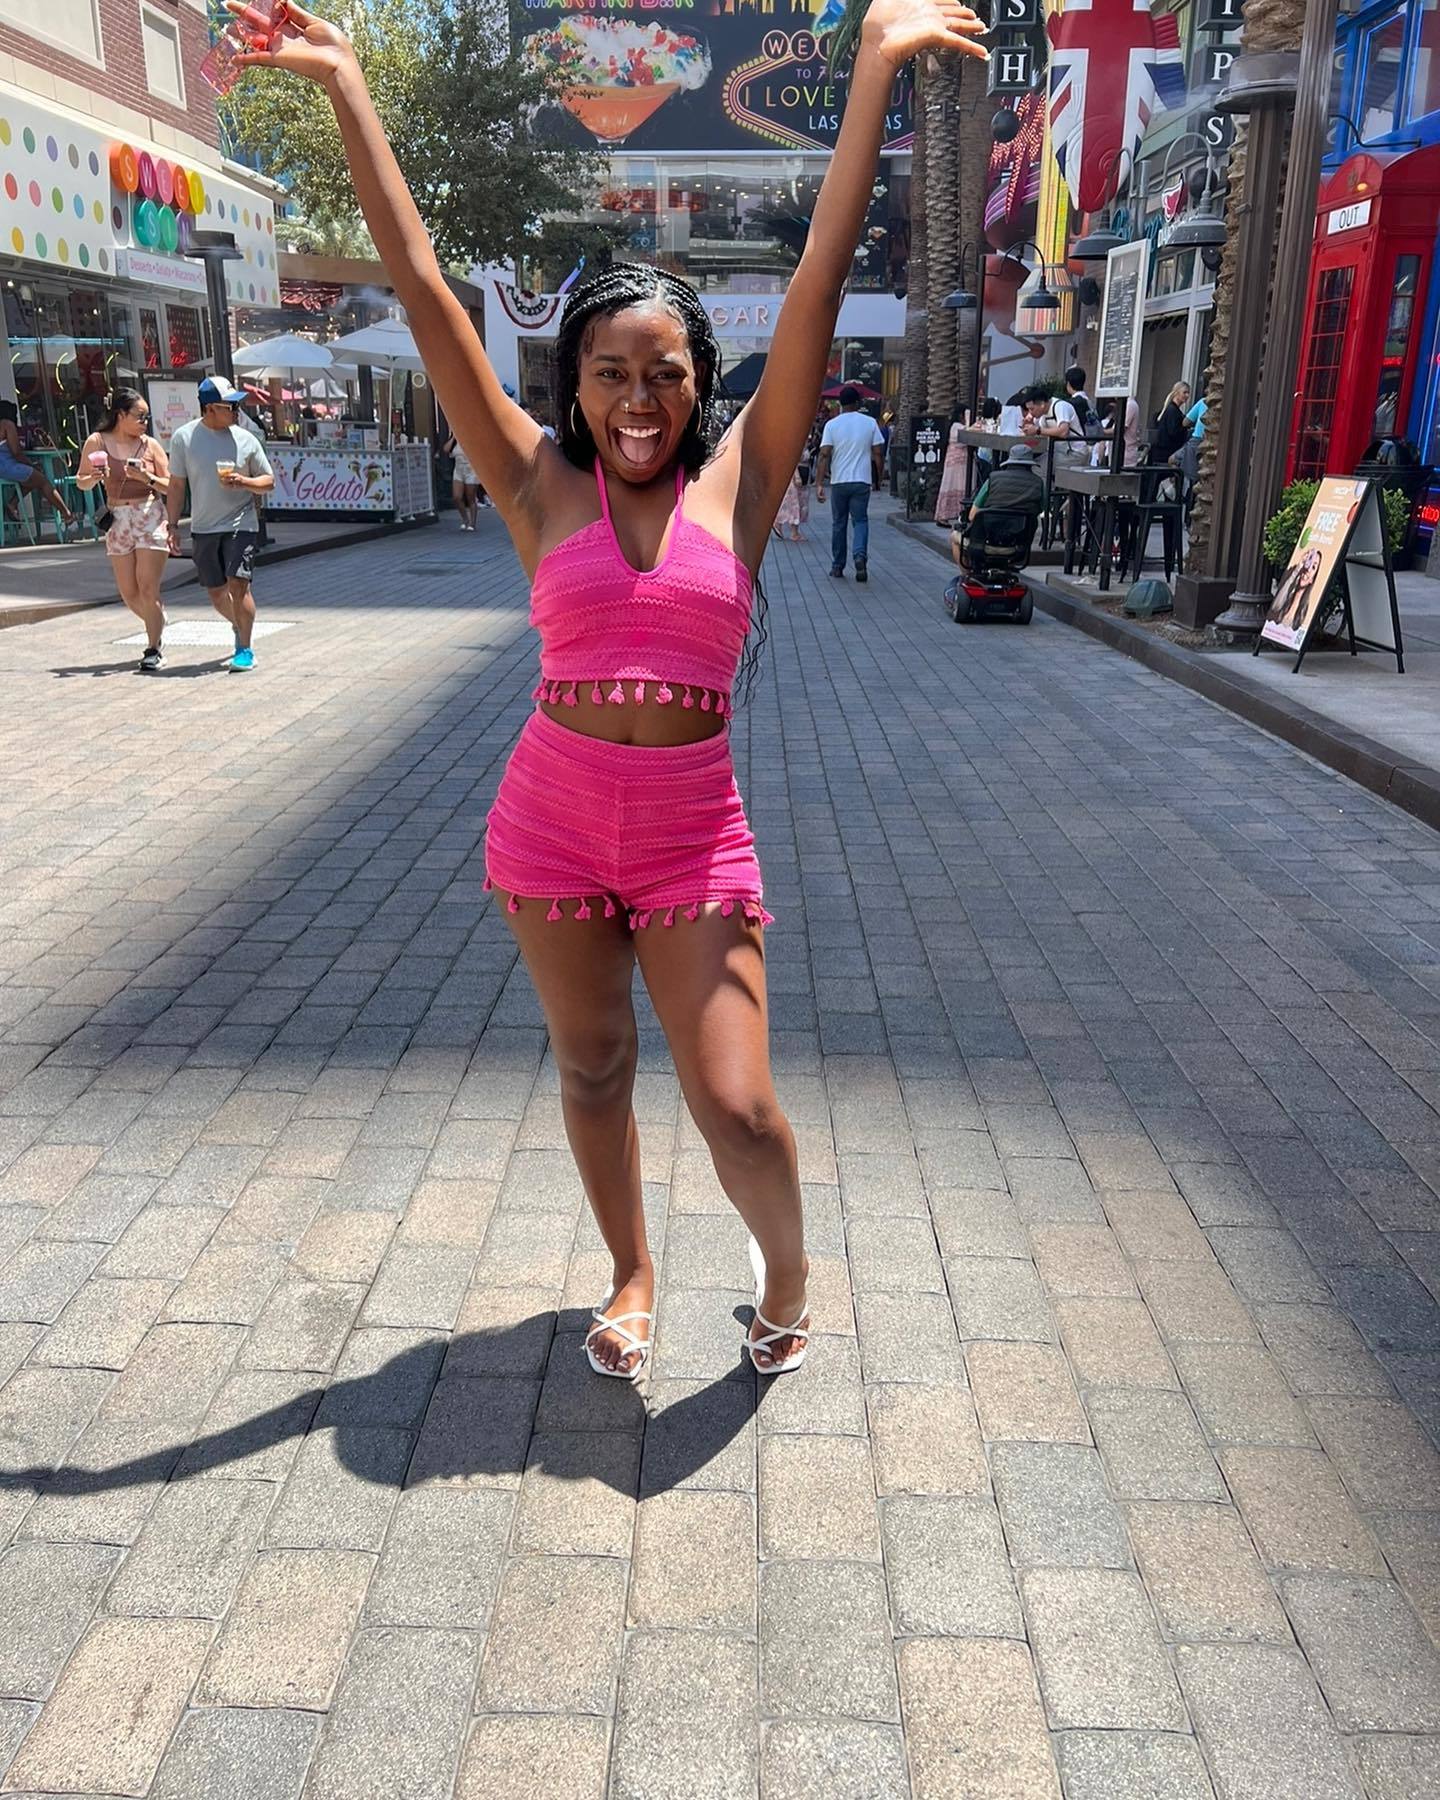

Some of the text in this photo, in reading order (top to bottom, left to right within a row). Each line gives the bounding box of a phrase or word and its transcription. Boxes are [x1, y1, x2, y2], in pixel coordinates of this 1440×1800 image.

[796, 68, 812, 78] TO
[766, 86, 835, 107] LOVE
[809, 114, 839, 130] LAS
[122, 152, 204, 209] SWEET
[1339, 206, 1360, 229] OUT
[709, 305, 769, 326] GAR
[296, 471, 365, 501] Gelato
